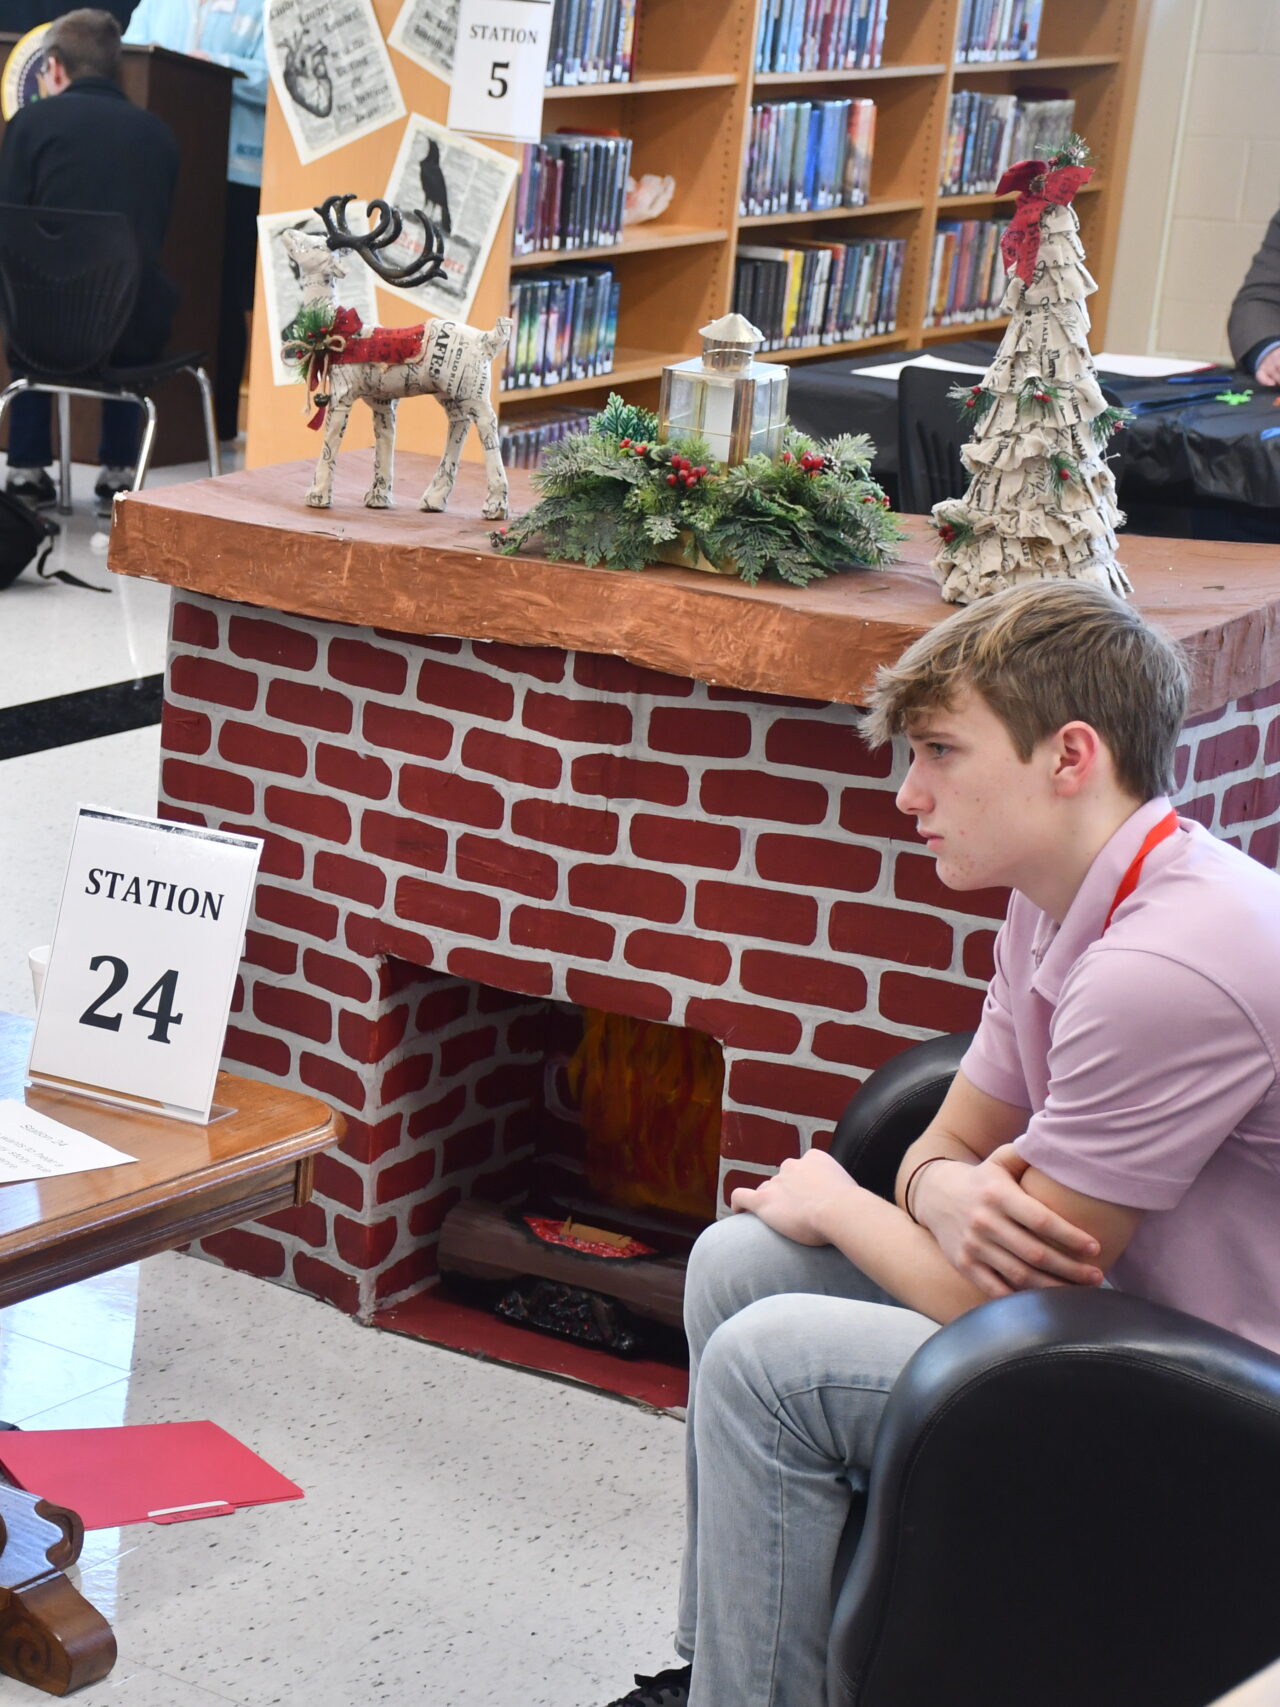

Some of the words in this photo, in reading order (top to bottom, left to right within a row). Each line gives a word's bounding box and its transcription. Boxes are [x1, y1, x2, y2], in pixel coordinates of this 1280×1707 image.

[470, 24, 538, 44] STATION
[488, 61, 510, 98] 5
[85, 868, 225, 921] STATION
[79, 955, 183, 1044] 24
